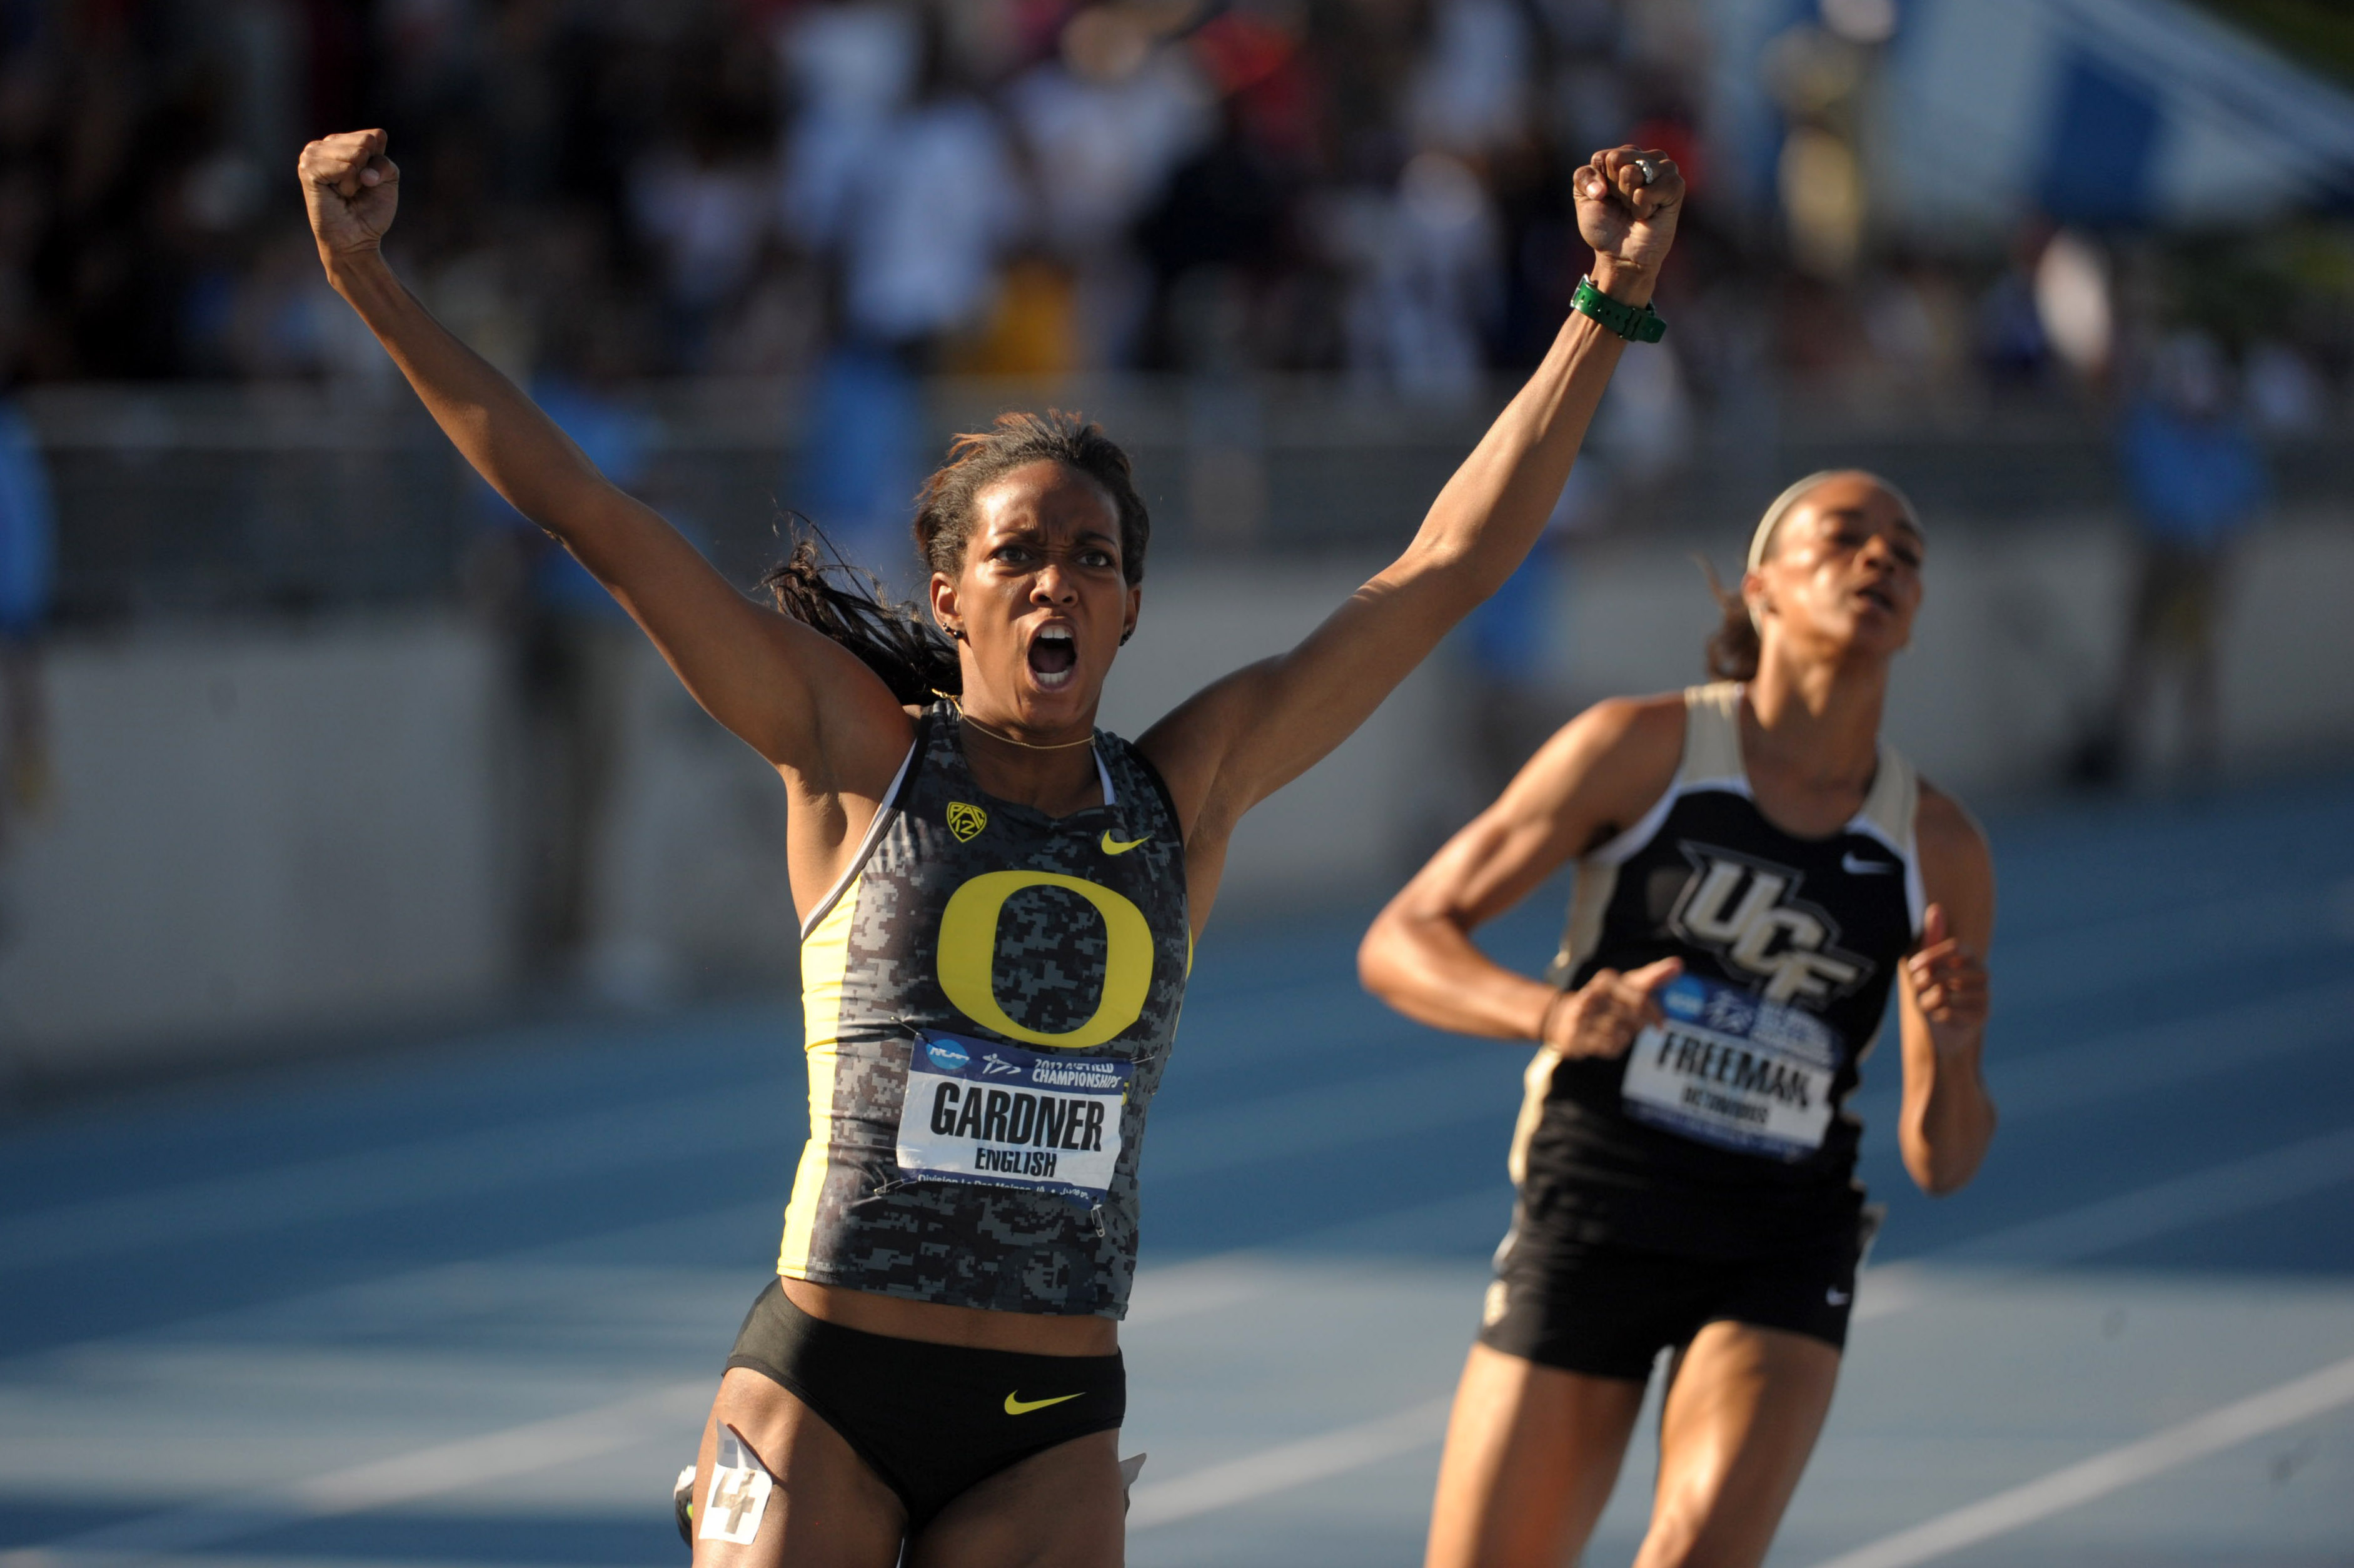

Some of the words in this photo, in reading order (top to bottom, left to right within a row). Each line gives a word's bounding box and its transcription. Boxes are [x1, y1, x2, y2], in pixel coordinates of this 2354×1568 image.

[950, 804, 985, 830] PAC
[955, 819, 975, 835] 12
[937, 870, 1154, 1048] O
[1683, 858, 1858, 1005] UCF
[1032, 1068, 1122, 1088] CHAMPIONSHIPS
[1657, 1030, 1811, 1109] FREEMAN
[929, 1081, 1105, 1152] GARDNER
[974, 1147, 1057, 1178] ENGLISH
[711, 1469, 756, 1535] 4
